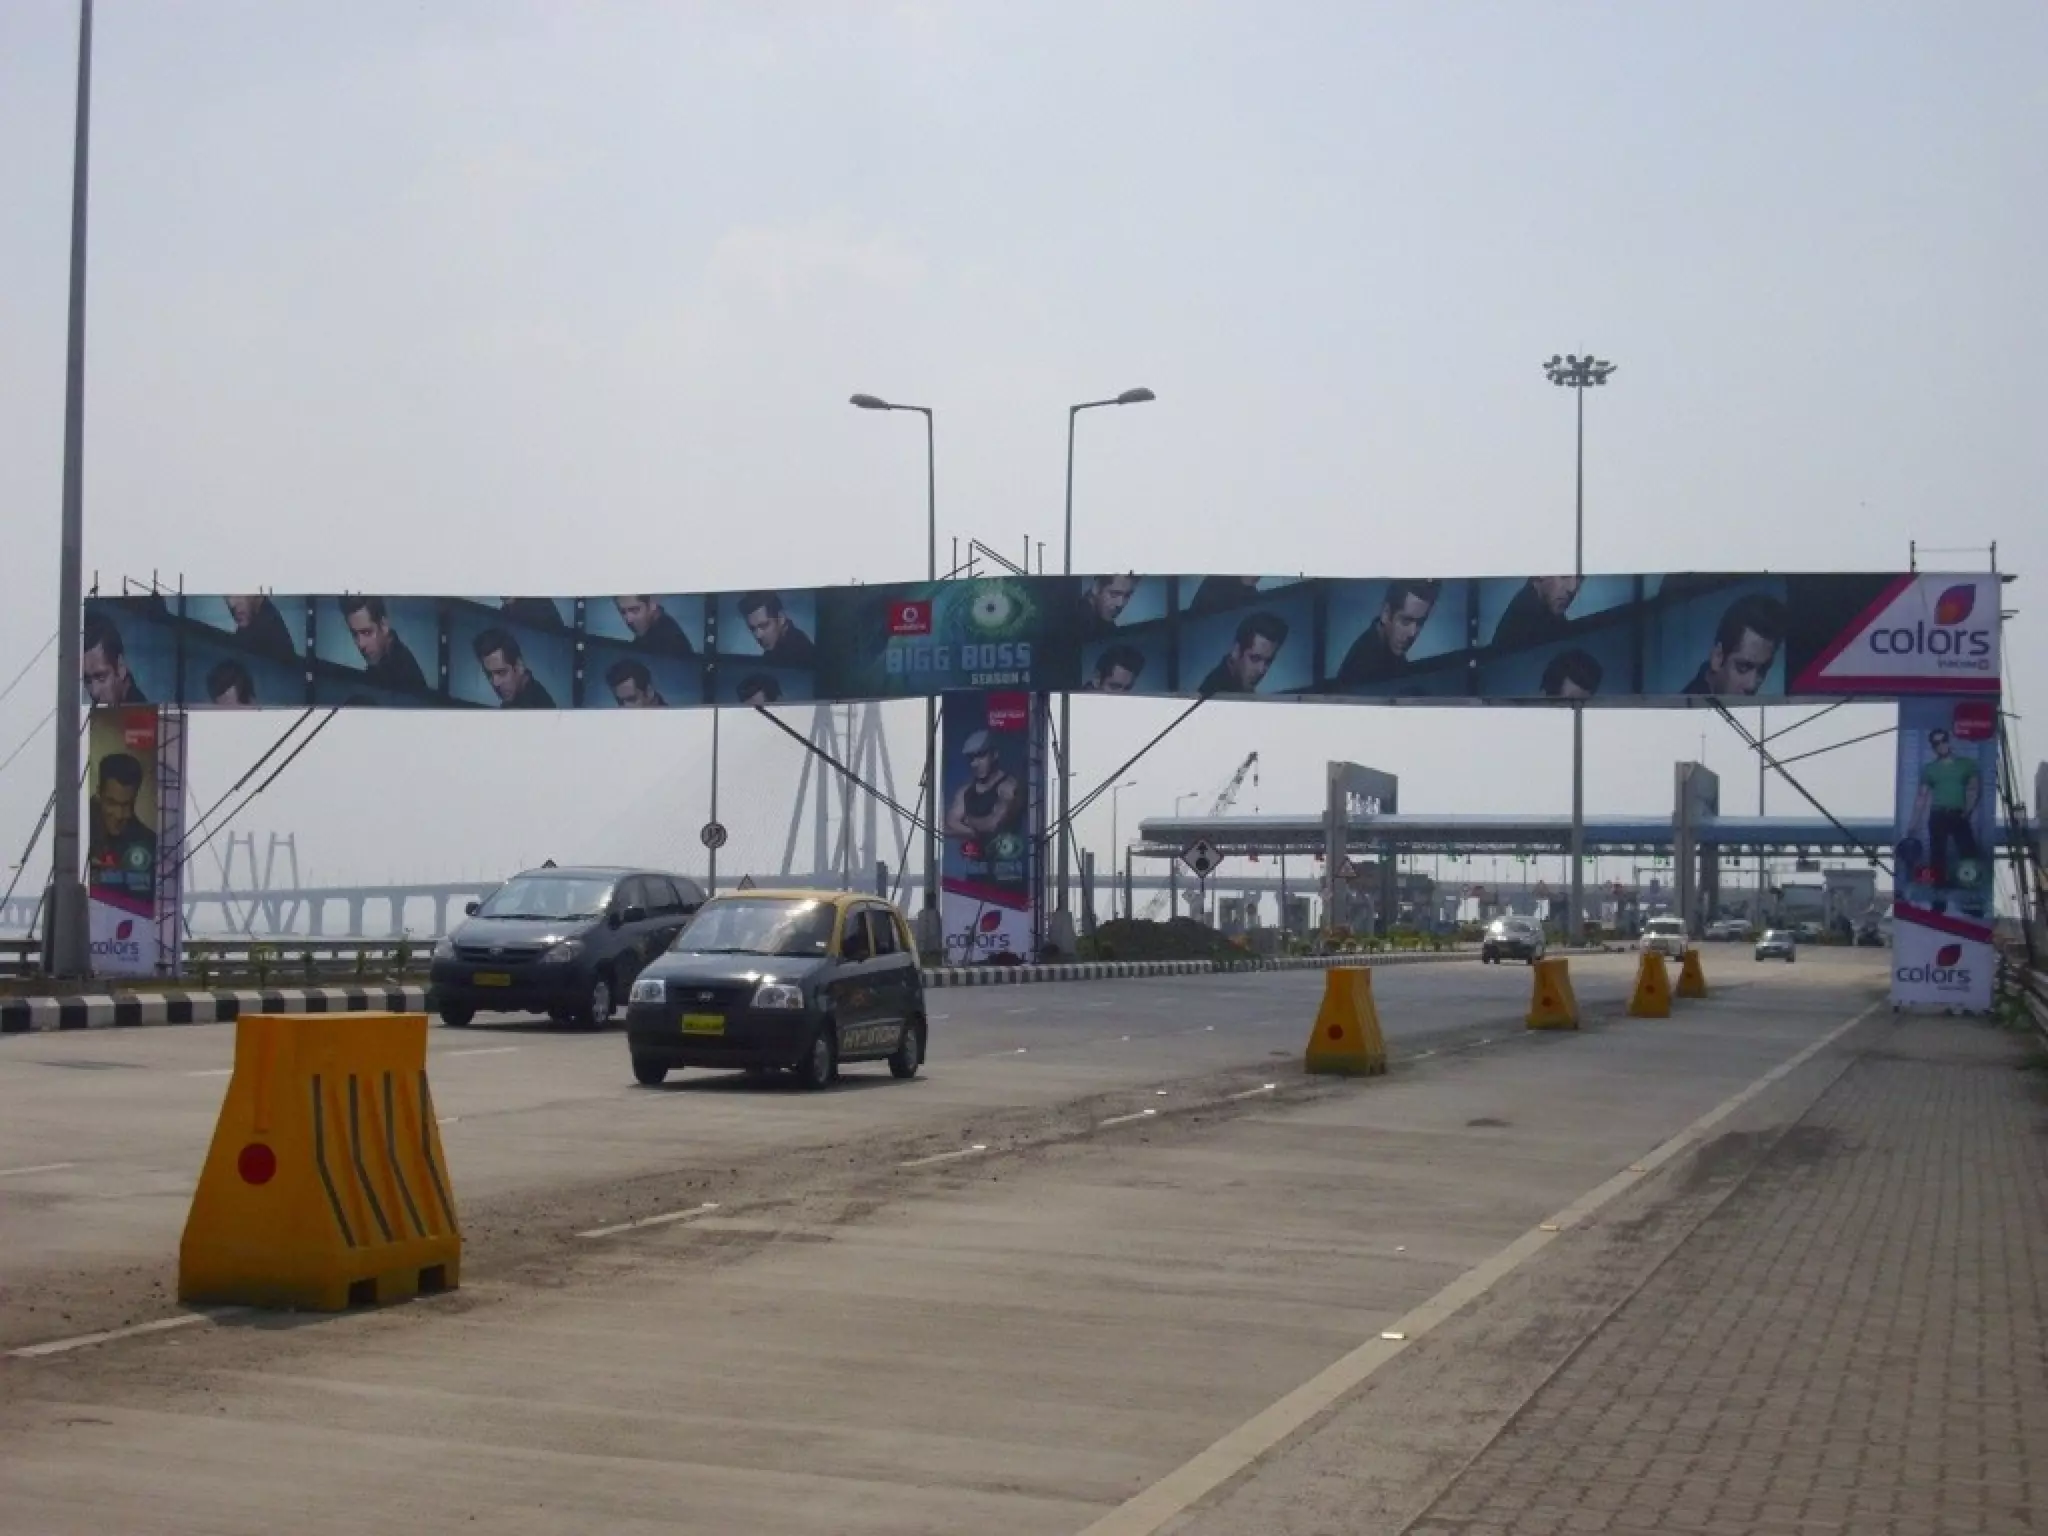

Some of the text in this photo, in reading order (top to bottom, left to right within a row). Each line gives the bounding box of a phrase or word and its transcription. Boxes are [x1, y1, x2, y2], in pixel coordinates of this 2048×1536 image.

[1870, 620, 1990, 656] colors
[886, 642, 1031, 673] BIGG BOSS
[971, 672, 1019, 685] SEASON
[945, 929, 1010, 949] coors
[1896, 963, 1972, 984] colors
